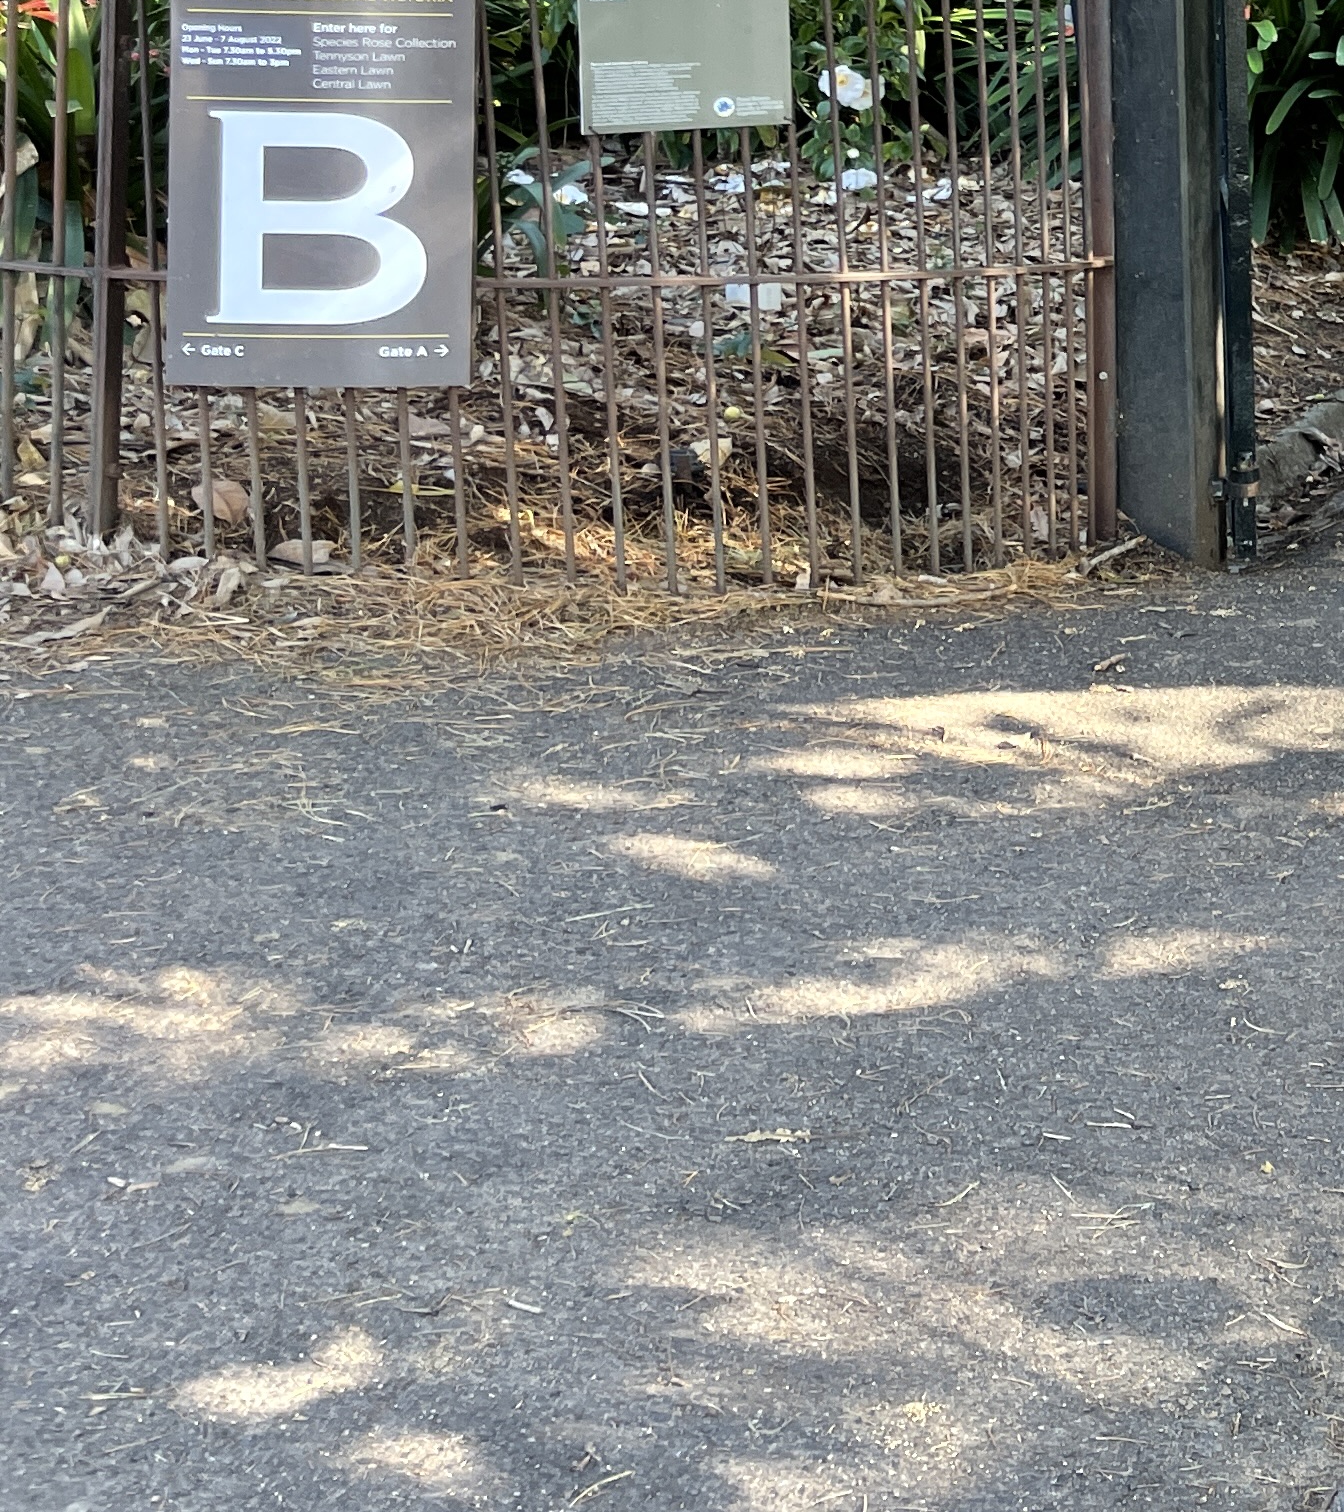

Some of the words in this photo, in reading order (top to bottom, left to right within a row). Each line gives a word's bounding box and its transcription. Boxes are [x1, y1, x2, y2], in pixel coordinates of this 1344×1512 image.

[312, 22, 346, 33] Enter
[349, 23, 376, 34] here
[379, 23, 399, 34] for
[193, 35, 213, 43] June
[220, 35, 226, 43] 7
[228, 36, 258, 45] August
[259, 36, 282, 44] 2022
[312, 36, 359, 48] Species
[362, 37, 392, 48] Rose
[395, 38, 457, 49] Collection
[256, 47, 266, 55] to
[312, 50, 369, 63] Tennyson
[372, 52, 406, 62] Lawn
[258, 58, 268, 66] to
[312, 64, 358, 75] Eastern
[360, 65, 394, 76] Lawn
[312, 78, 355, 89] Central
[358, 79, 392, 90] Lawn
[205, 110, 428, 325] B
[201, 344, 232, 356] Gate
[234, 345, 245, 357] C
[379, 346, 413, 358] Gate
[416, 346, 428, 357] A
